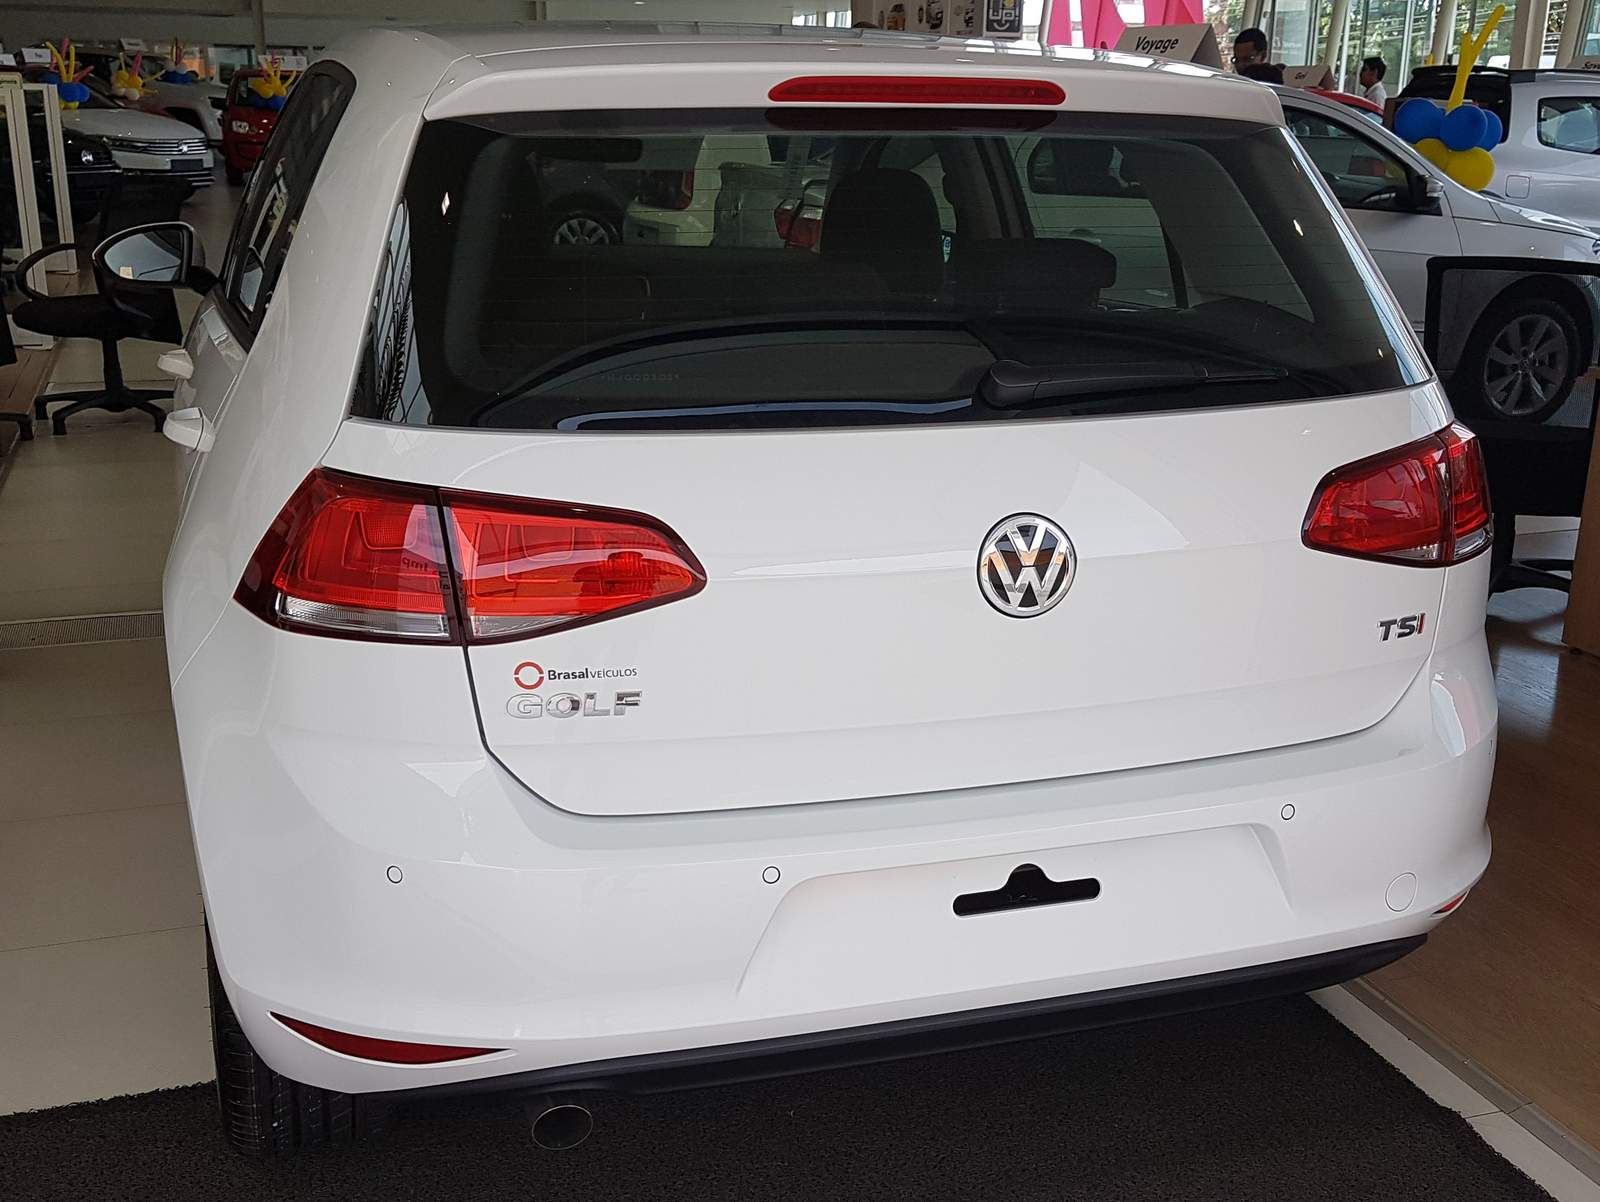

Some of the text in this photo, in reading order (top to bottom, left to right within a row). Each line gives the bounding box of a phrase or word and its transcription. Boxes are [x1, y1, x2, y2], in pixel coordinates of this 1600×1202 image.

[1135, 36, 1179, 54] Voyage
[1377, 612, 1426, 642] TSI
[548, 668, 589, 681] Brasal
[506, 691, 642, 719] GOLF
